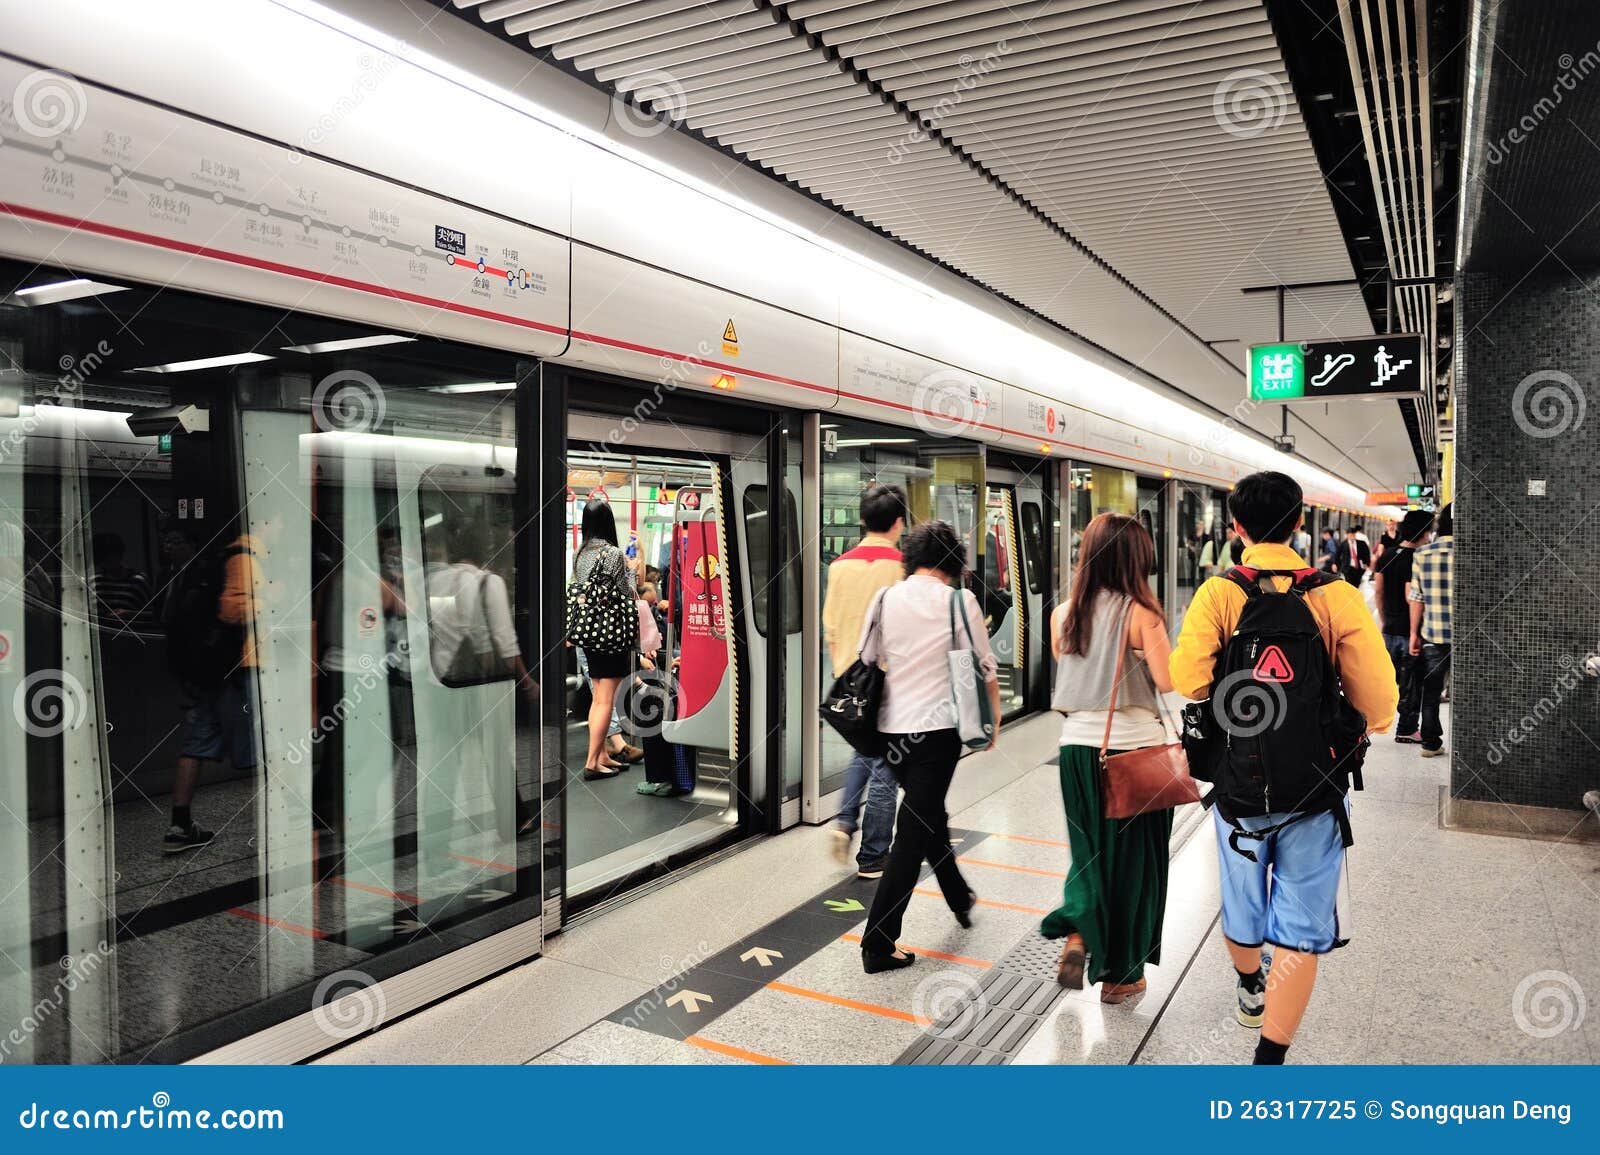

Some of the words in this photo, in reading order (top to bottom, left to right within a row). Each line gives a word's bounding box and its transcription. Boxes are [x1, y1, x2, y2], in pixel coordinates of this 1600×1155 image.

[437, 228, 464, 246] 尖沙咀
[1263, 379, 1294, 390] EXIT
[689, 603, 722, 615] 請讓給
